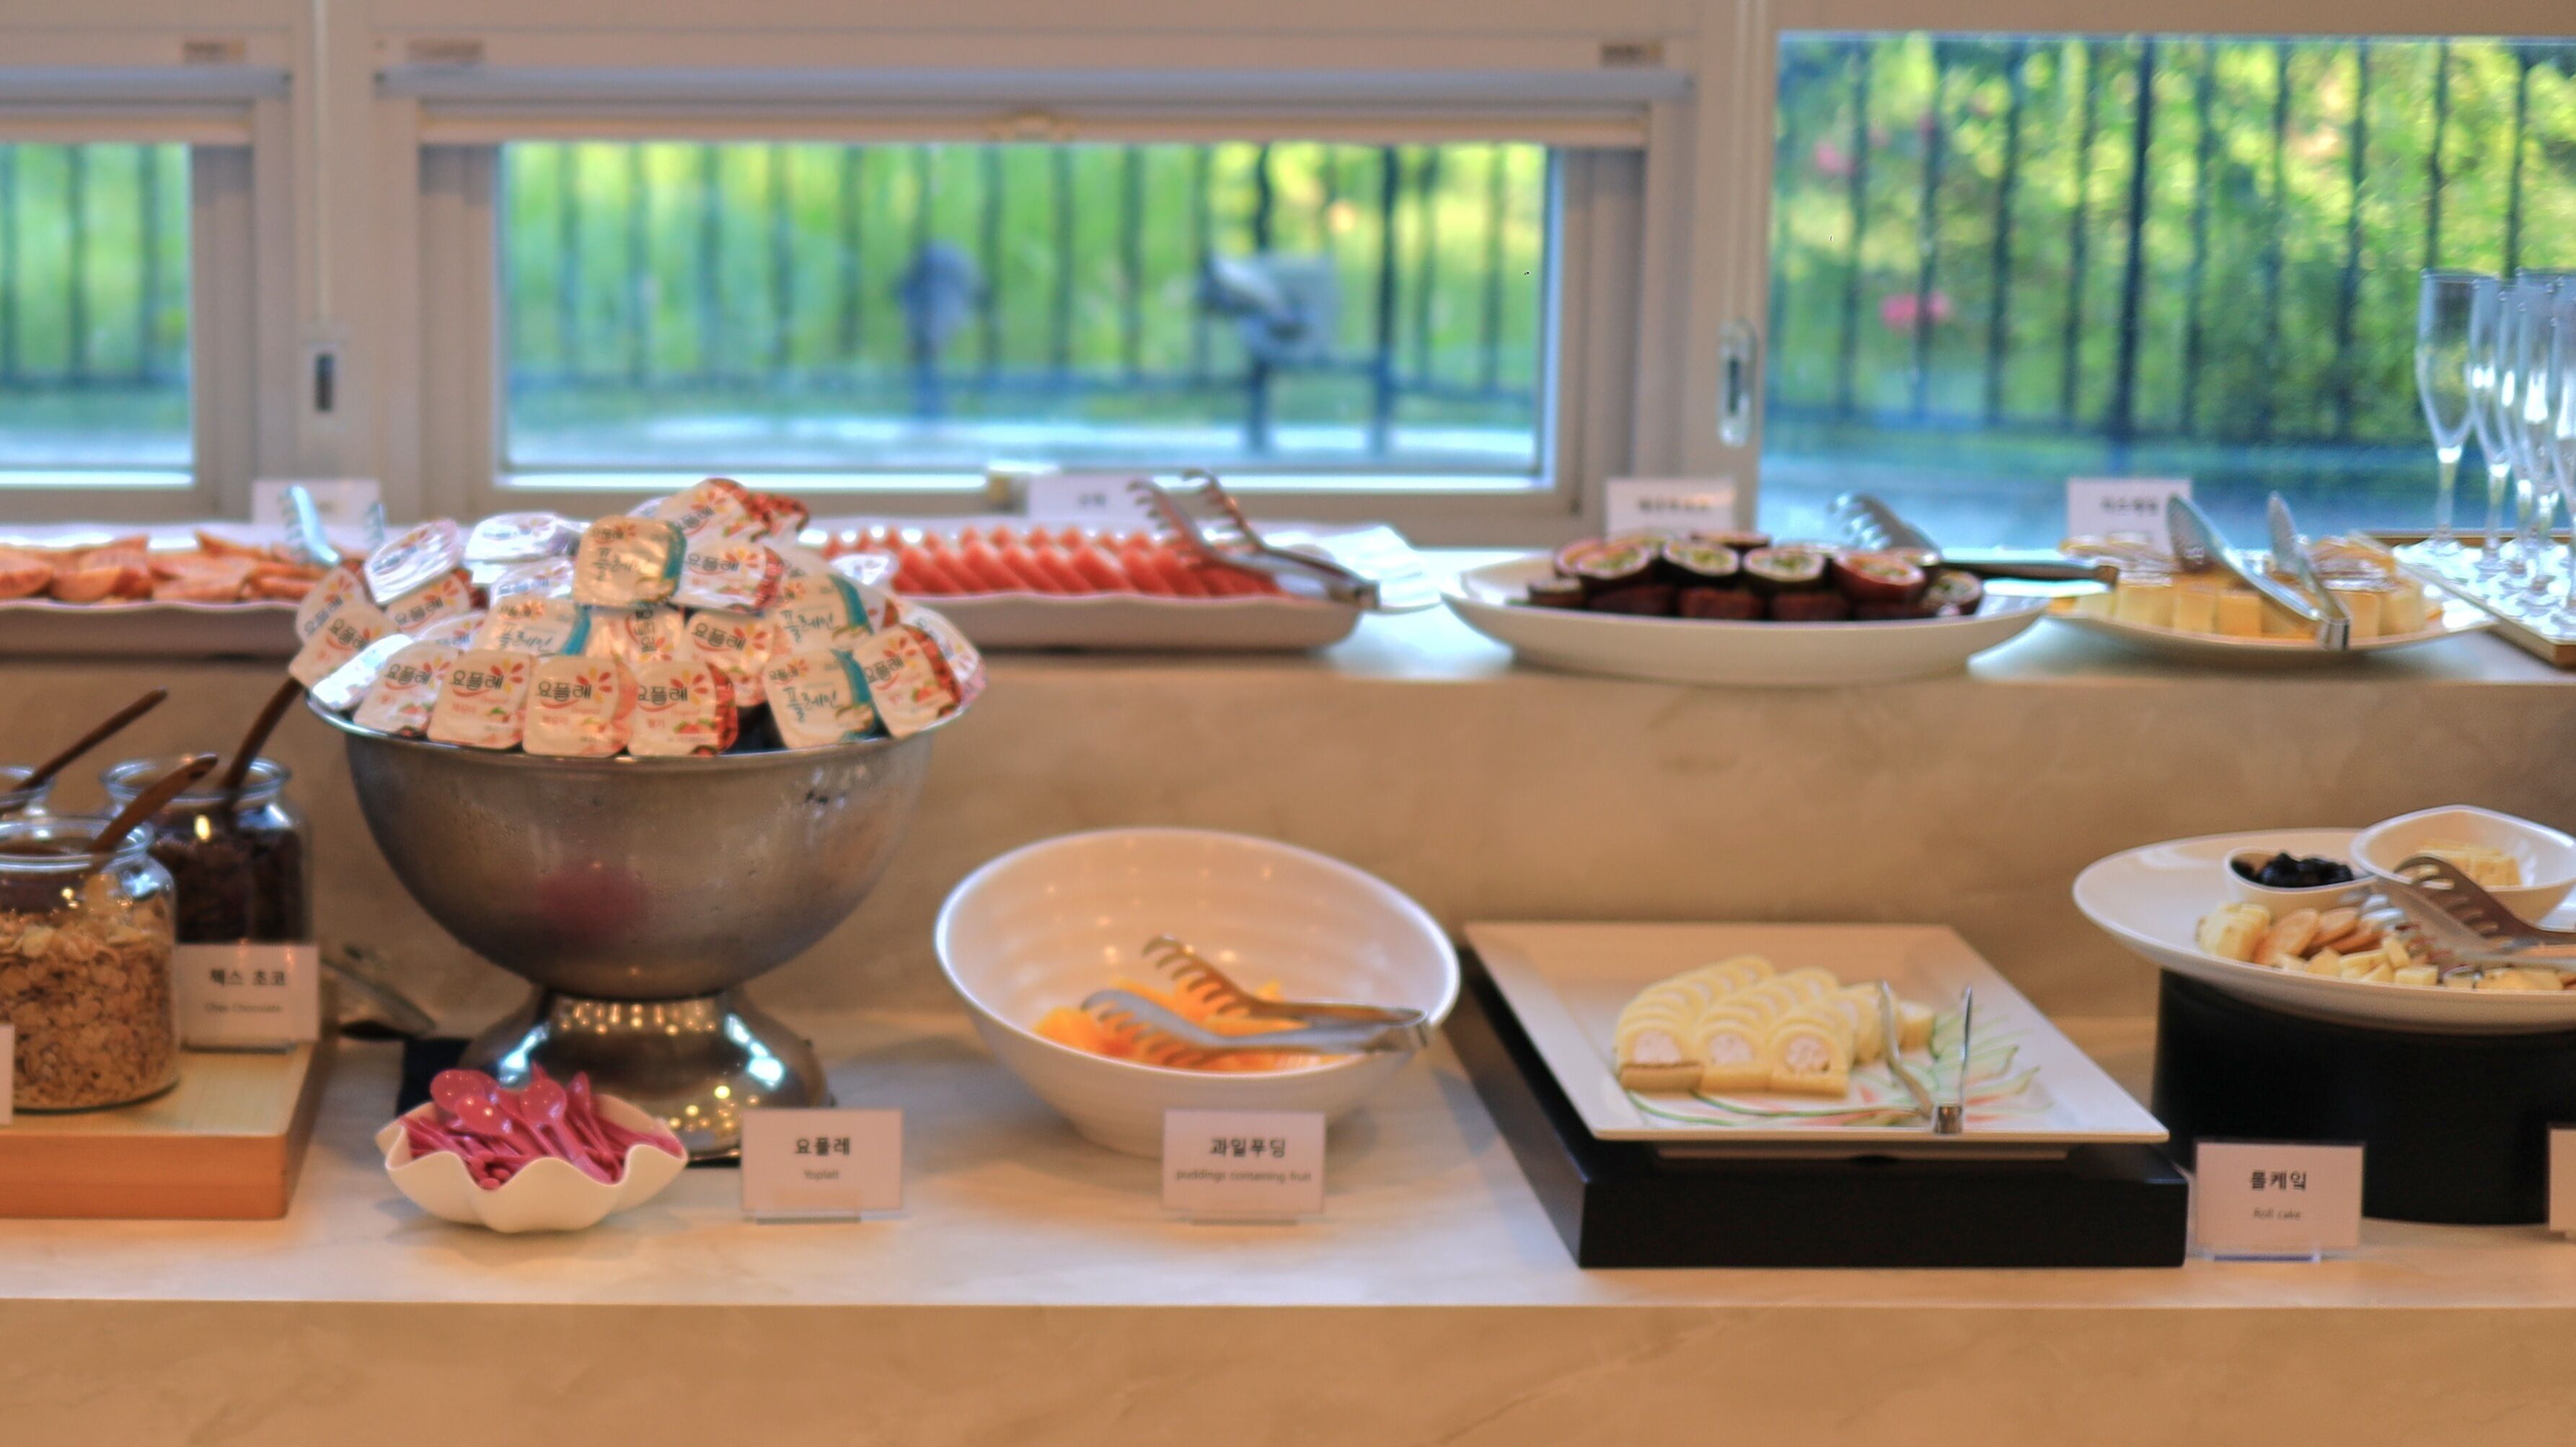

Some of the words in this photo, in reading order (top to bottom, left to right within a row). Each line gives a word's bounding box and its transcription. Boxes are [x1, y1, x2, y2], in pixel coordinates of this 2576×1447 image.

[686, 553, 739, 571] 요플레
[395, 597, 444, 624] 요플레
[691, 623, 747, 650] 요플레
[384, 664, 432, 685] 요플레
[864, 655, 904, 683] 요플레
[449, 670, 503, 691] 요플레
[536, 681, 591, 702] 요플레
[638, 685, 687, 705] 요플레
[252, 970, 286, 986] 초코
[794, 1138, 850, 1155] 요플레
[1209, 1138, 1285, 1158] 과일푸딩
[804, 1169, 839, 1181] Yoplait
[1175, 1169, 1226, 1182] puddings
[1230, 1171, 1286, 1183] containing
[1290, 1170, 1312, 1181] fruit
